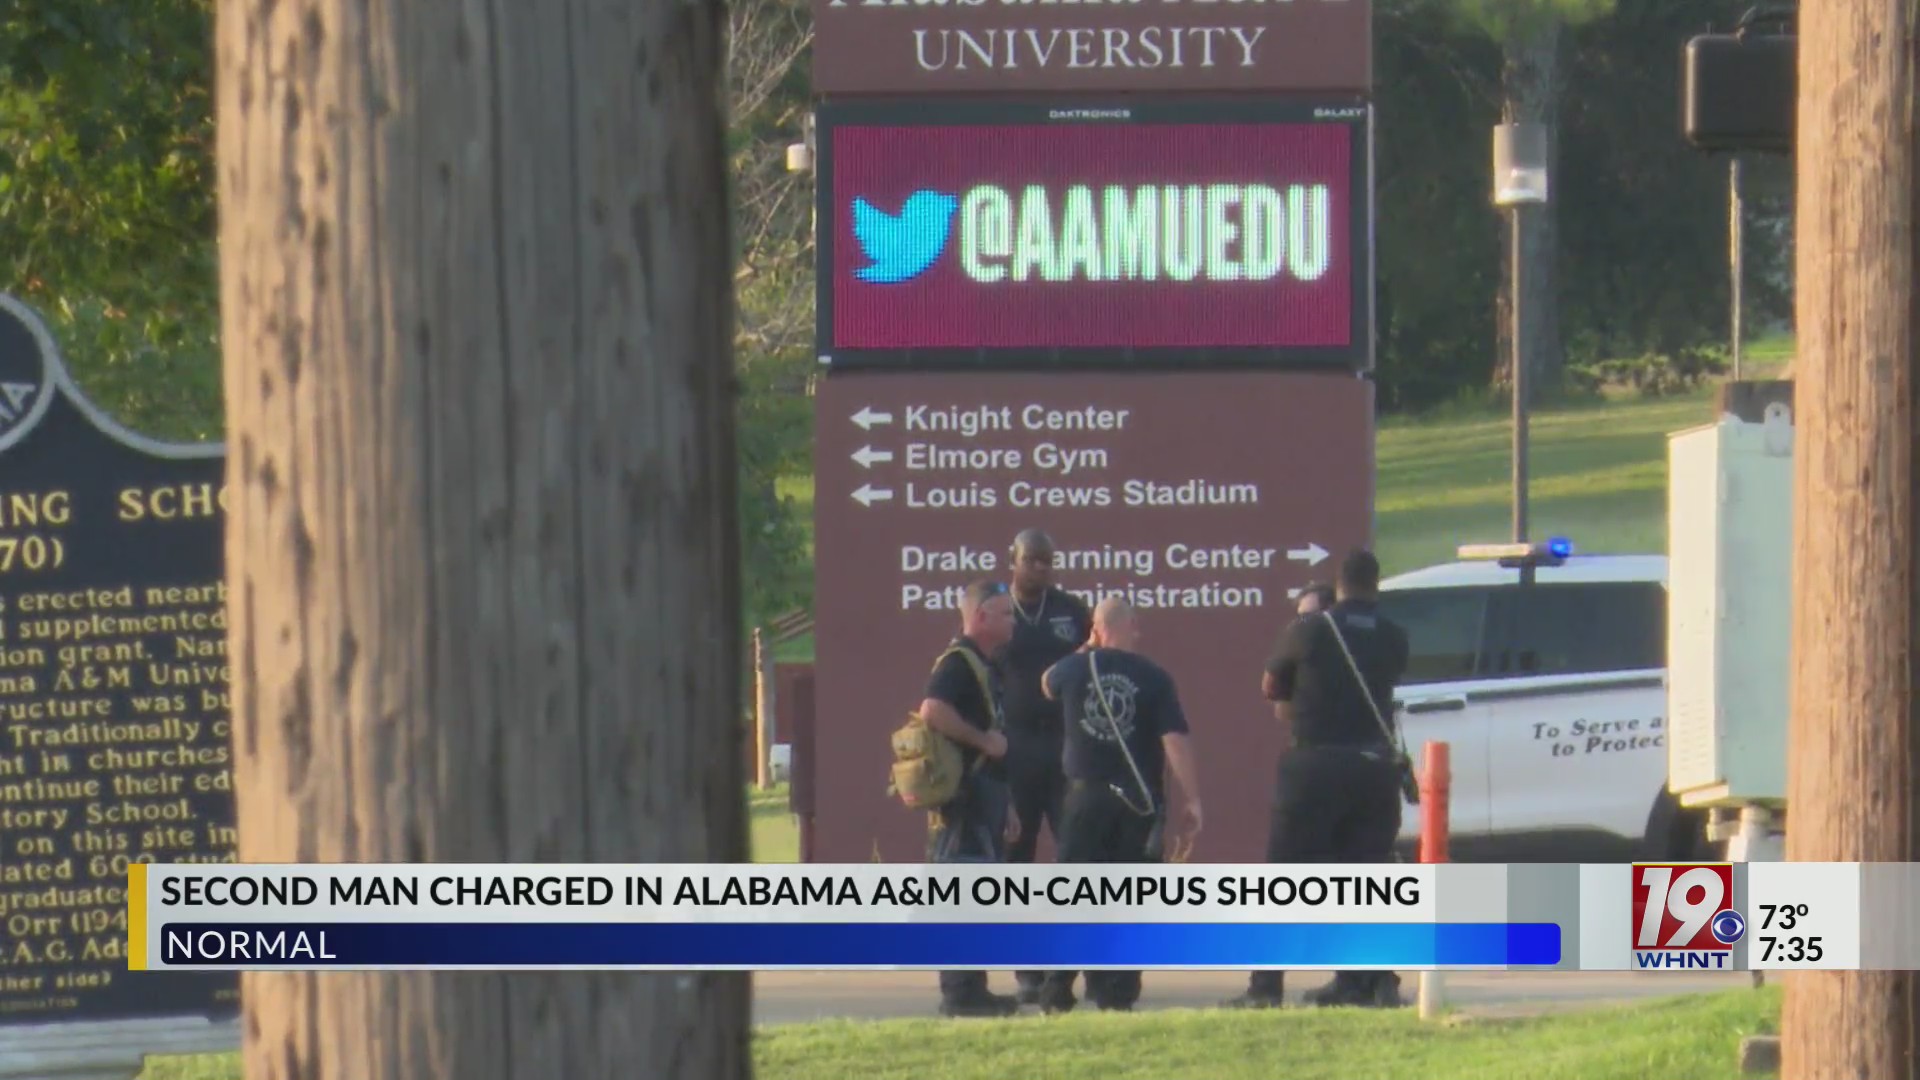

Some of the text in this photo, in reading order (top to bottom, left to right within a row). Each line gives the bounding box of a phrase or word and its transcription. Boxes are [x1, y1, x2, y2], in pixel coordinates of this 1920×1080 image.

[912, 26, 1267, 70] UNIVERSITY
[1048, 108, 1131, 119] DAKTRONICS
[1313, 107, 1363, 117] GALAXY
[959, 183, 1331, 283] @AAMUEDU
[905, 404, 1130, 437] Knight Center
[906, 442, 1108, 475] Elmore Gym
[118, 483, 229, 520] SCH
[906, 479, 1259, 508] Louis Crews Stadium
[0, 536, 64, 571] 70)
[901, 543, 1276, 576] Drake arning Center
[18, 584, 132, 612] erected
[20, 611, 226, 640] supplemented
[58, 640, 153, 669] grant.
[132, 694, 187, 713] was
[8, 718, 200, 748] Traditionally
[1533, 722, 1560, 740] To
[1571, 718, 1640, 737] Serve
[41, 750, 71, 773] in
[89, 745, 229, 771] churches
[1551, 735, 1664, 757] to Protec
[113, 772, 184, 795] their
[195, 770, 231, 791] ed
[3, 799, 197, 830] tory School.
[17, 822, 237, 855] on this site in
[0, 886, 128, 917] raduate
[8, 914, 61, 936] Orr
